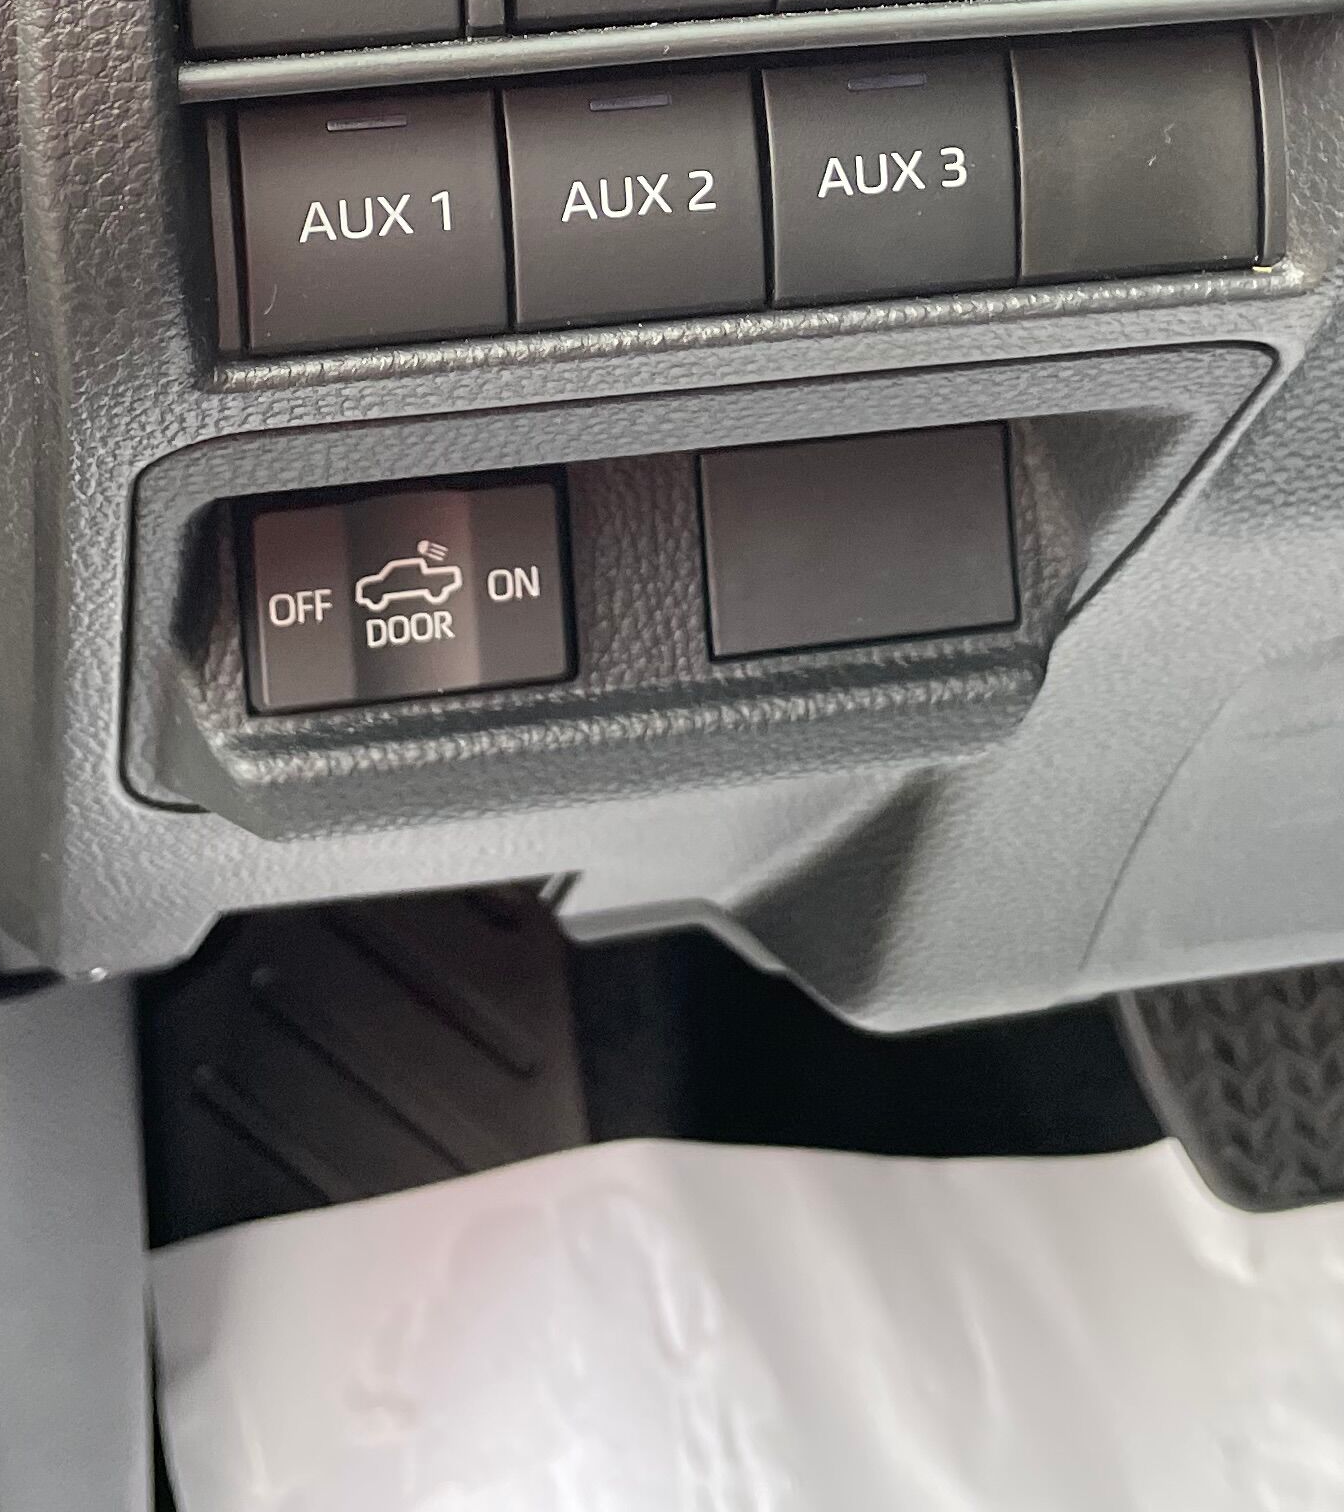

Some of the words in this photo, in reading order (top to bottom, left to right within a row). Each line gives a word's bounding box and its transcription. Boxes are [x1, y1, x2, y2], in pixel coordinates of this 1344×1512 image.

[816, 150, 927, 199] AUX
[939, 146, 968, 189] 3
[298, 193, 415, 244] AUX
[430, 190, 452, 232] 1
[560, 172, 674, 224] AUX
[687, 169, 718, 212] 2
[486, 564, 541, 603] ON
[267, 587, 333, 628] OFF
[365, 609, 456, 649] DOOR
